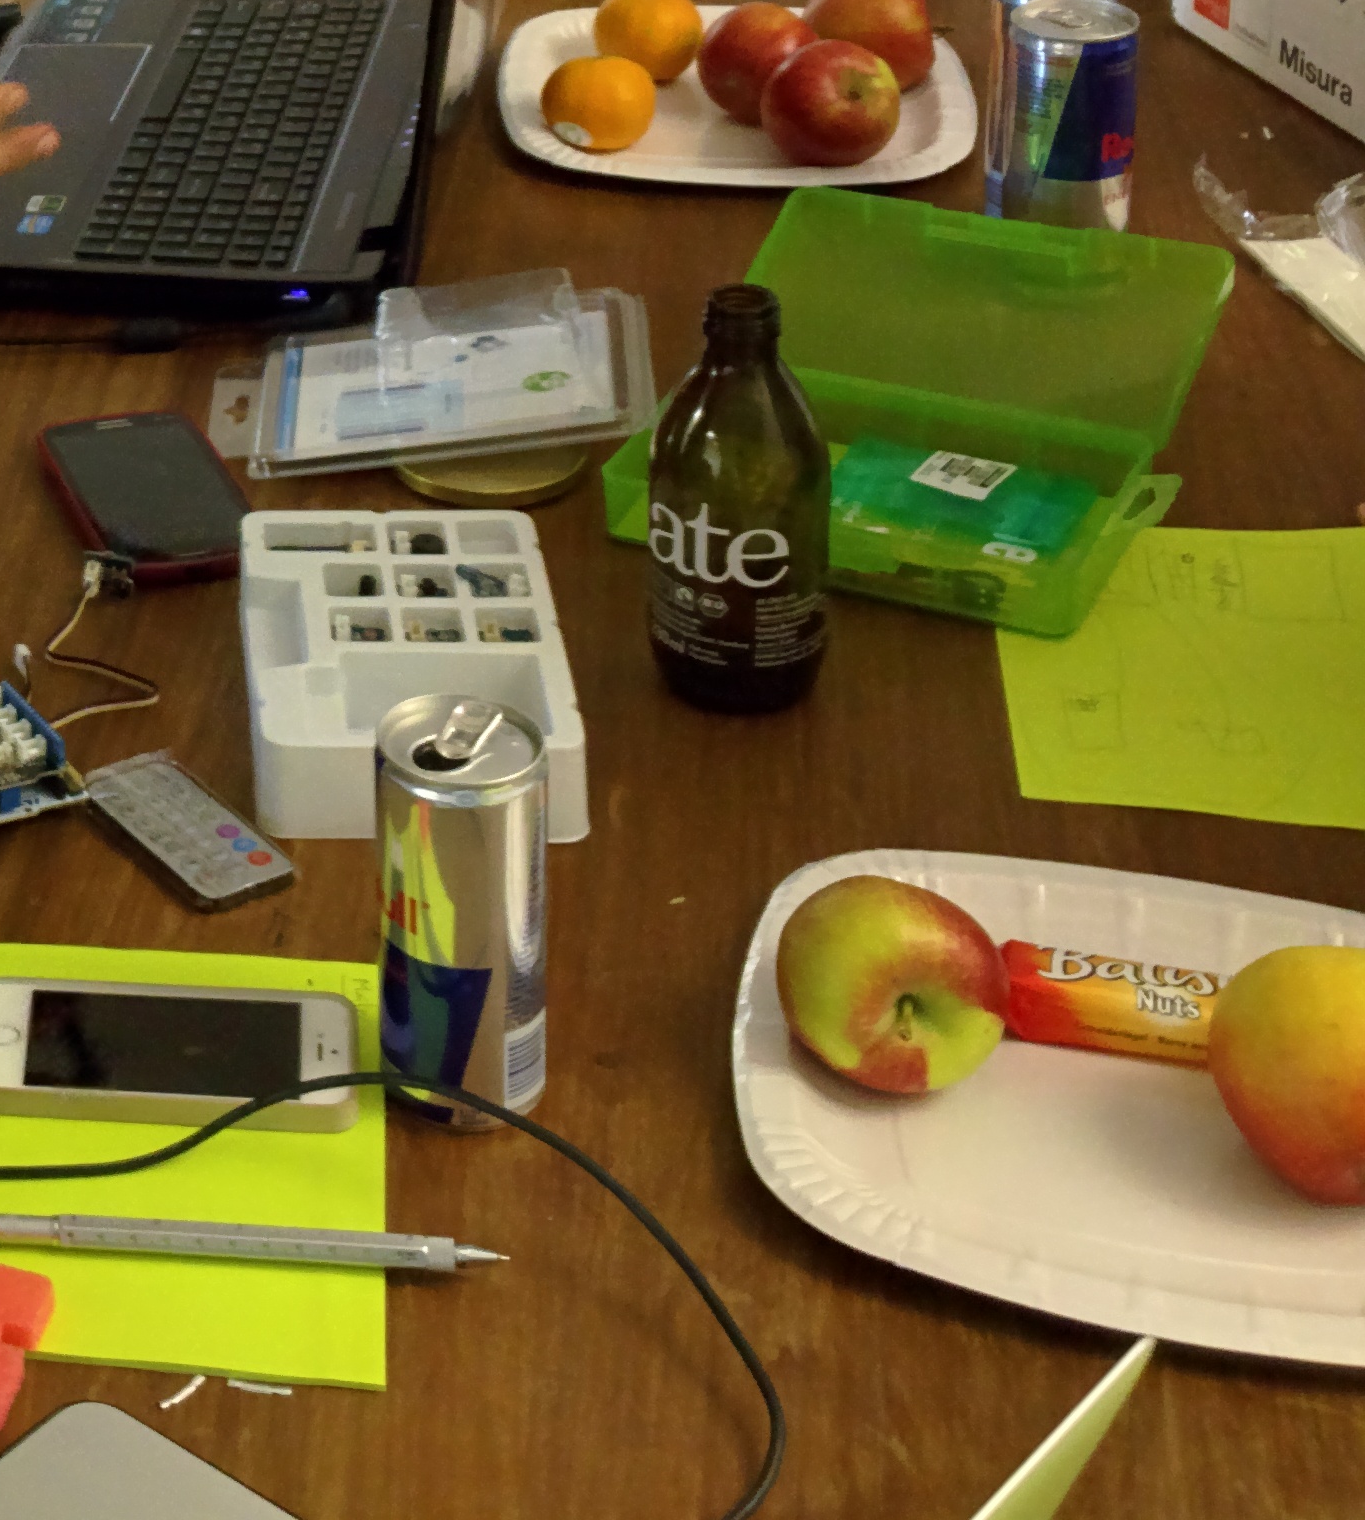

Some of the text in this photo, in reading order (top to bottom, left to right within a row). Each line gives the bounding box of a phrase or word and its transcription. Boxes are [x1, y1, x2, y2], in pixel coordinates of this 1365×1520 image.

[1278, 37, 1354, 107] Misura
[649, 502, 790, 589] ate
[1136, 986, 1201, 1020] Nuts
